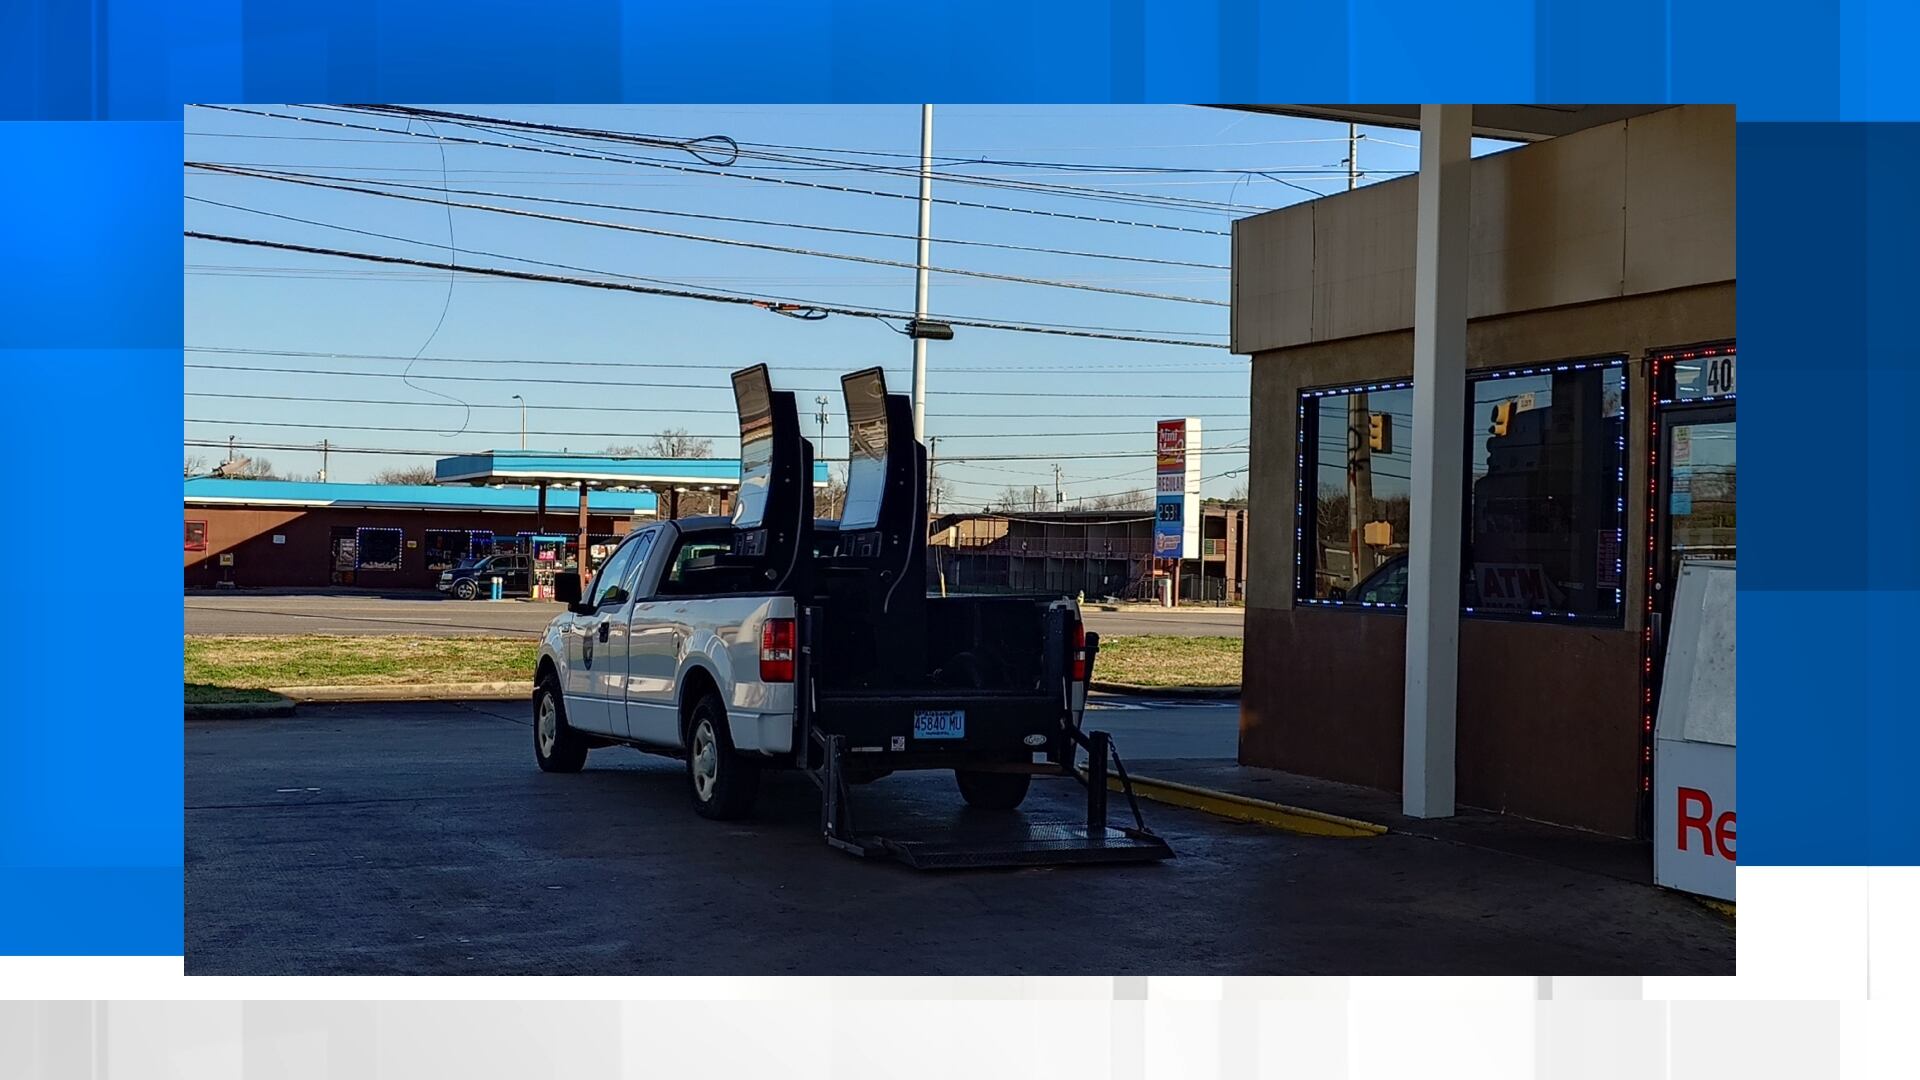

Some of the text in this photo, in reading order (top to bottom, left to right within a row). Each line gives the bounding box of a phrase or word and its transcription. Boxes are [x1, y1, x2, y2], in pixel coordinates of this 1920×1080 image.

[1707, 358, 1732, 393] 40
[1158, 476, 1184, 492] REGULAR
[1483, 567, 1545, 600] ATM
[915, 715, 962, 731] 45840 MU
[1676, 785, 1736, 862] Re
